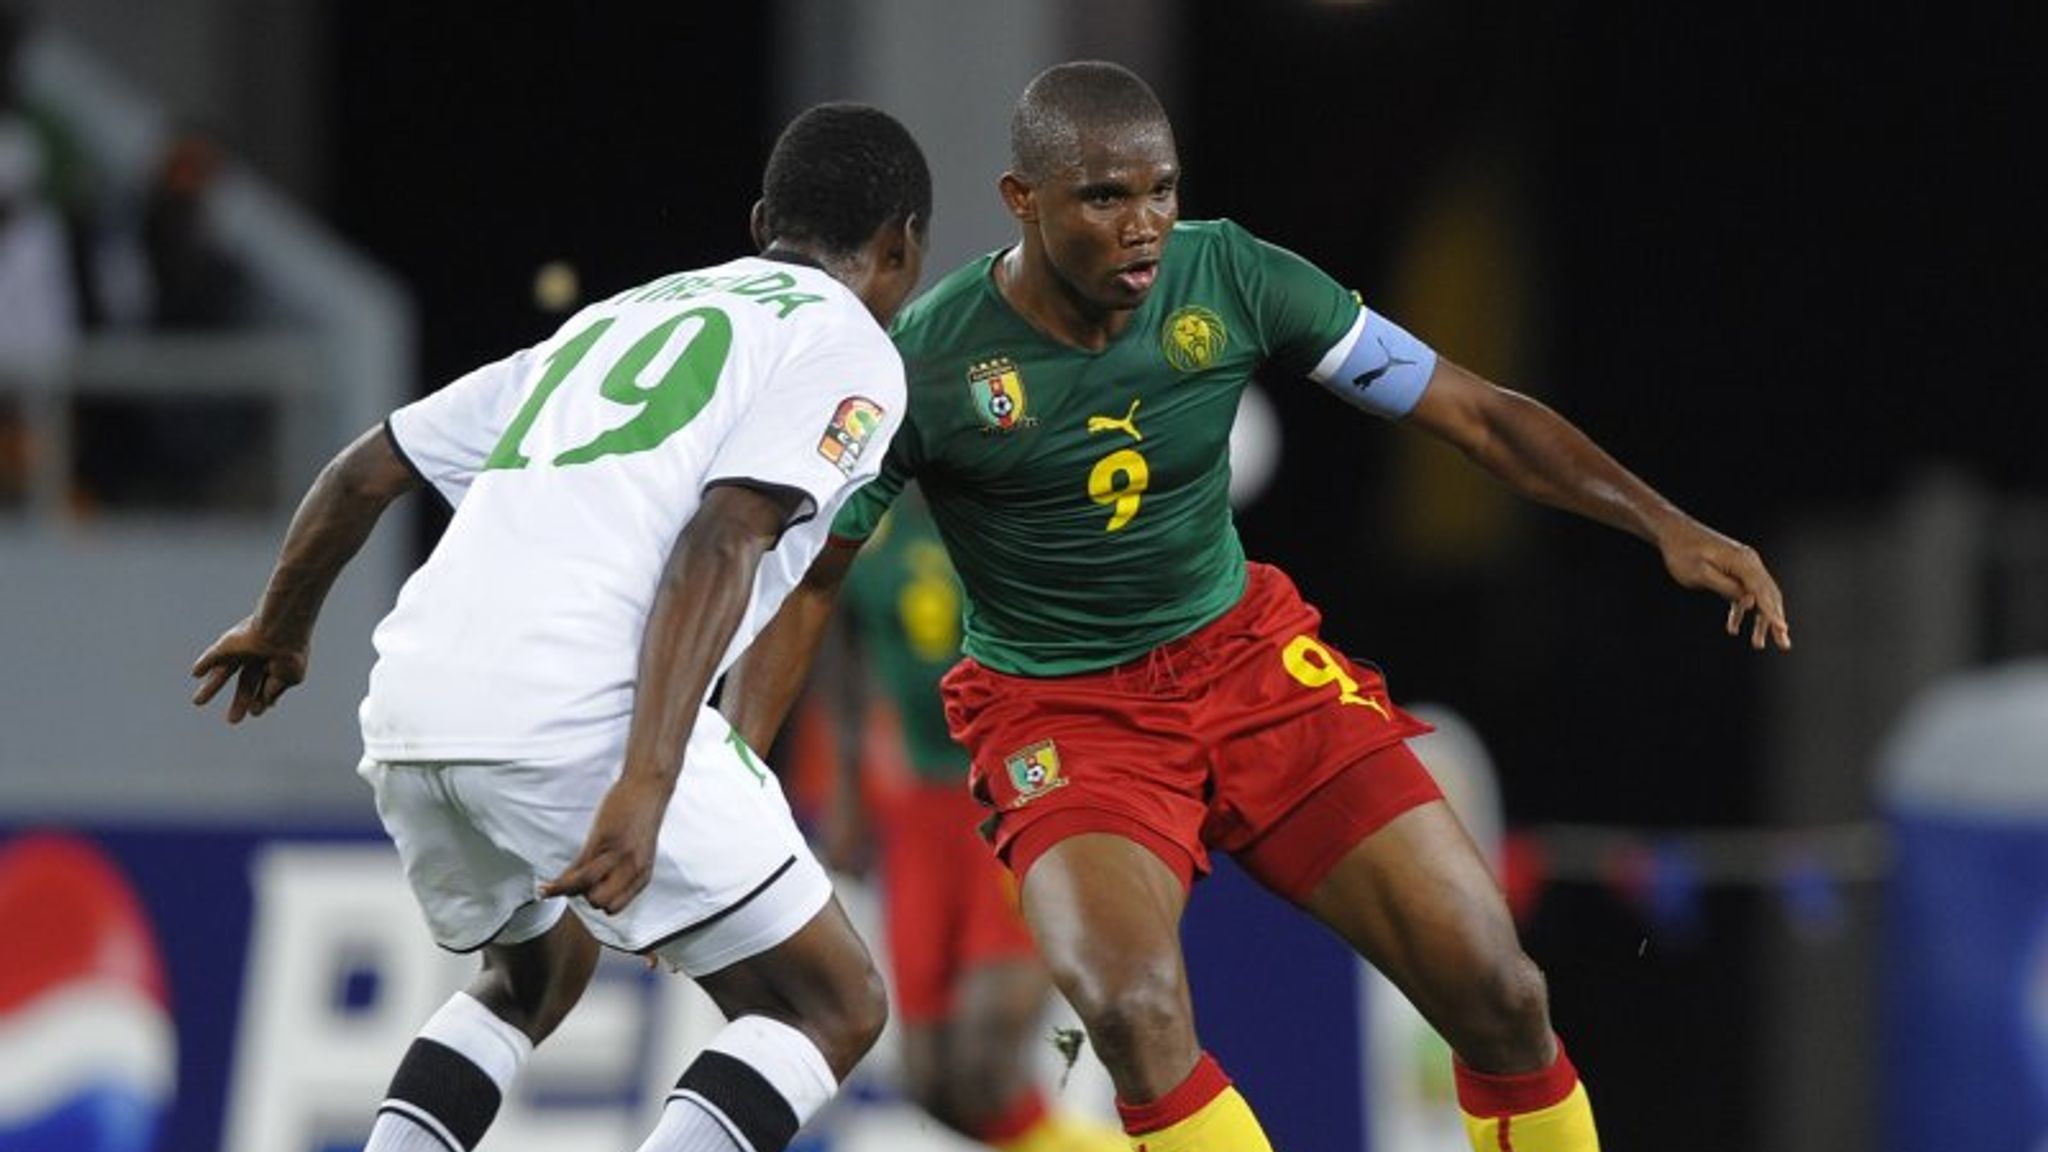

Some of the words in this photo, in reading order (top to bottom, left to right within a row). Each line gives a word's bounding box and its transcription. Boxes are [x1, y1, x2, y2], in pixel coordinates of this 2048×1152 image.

[485, 306, 733, 468] 19
[1088, 449, 1149, 532] 9
[1283, 634, 1358, 693] 9
